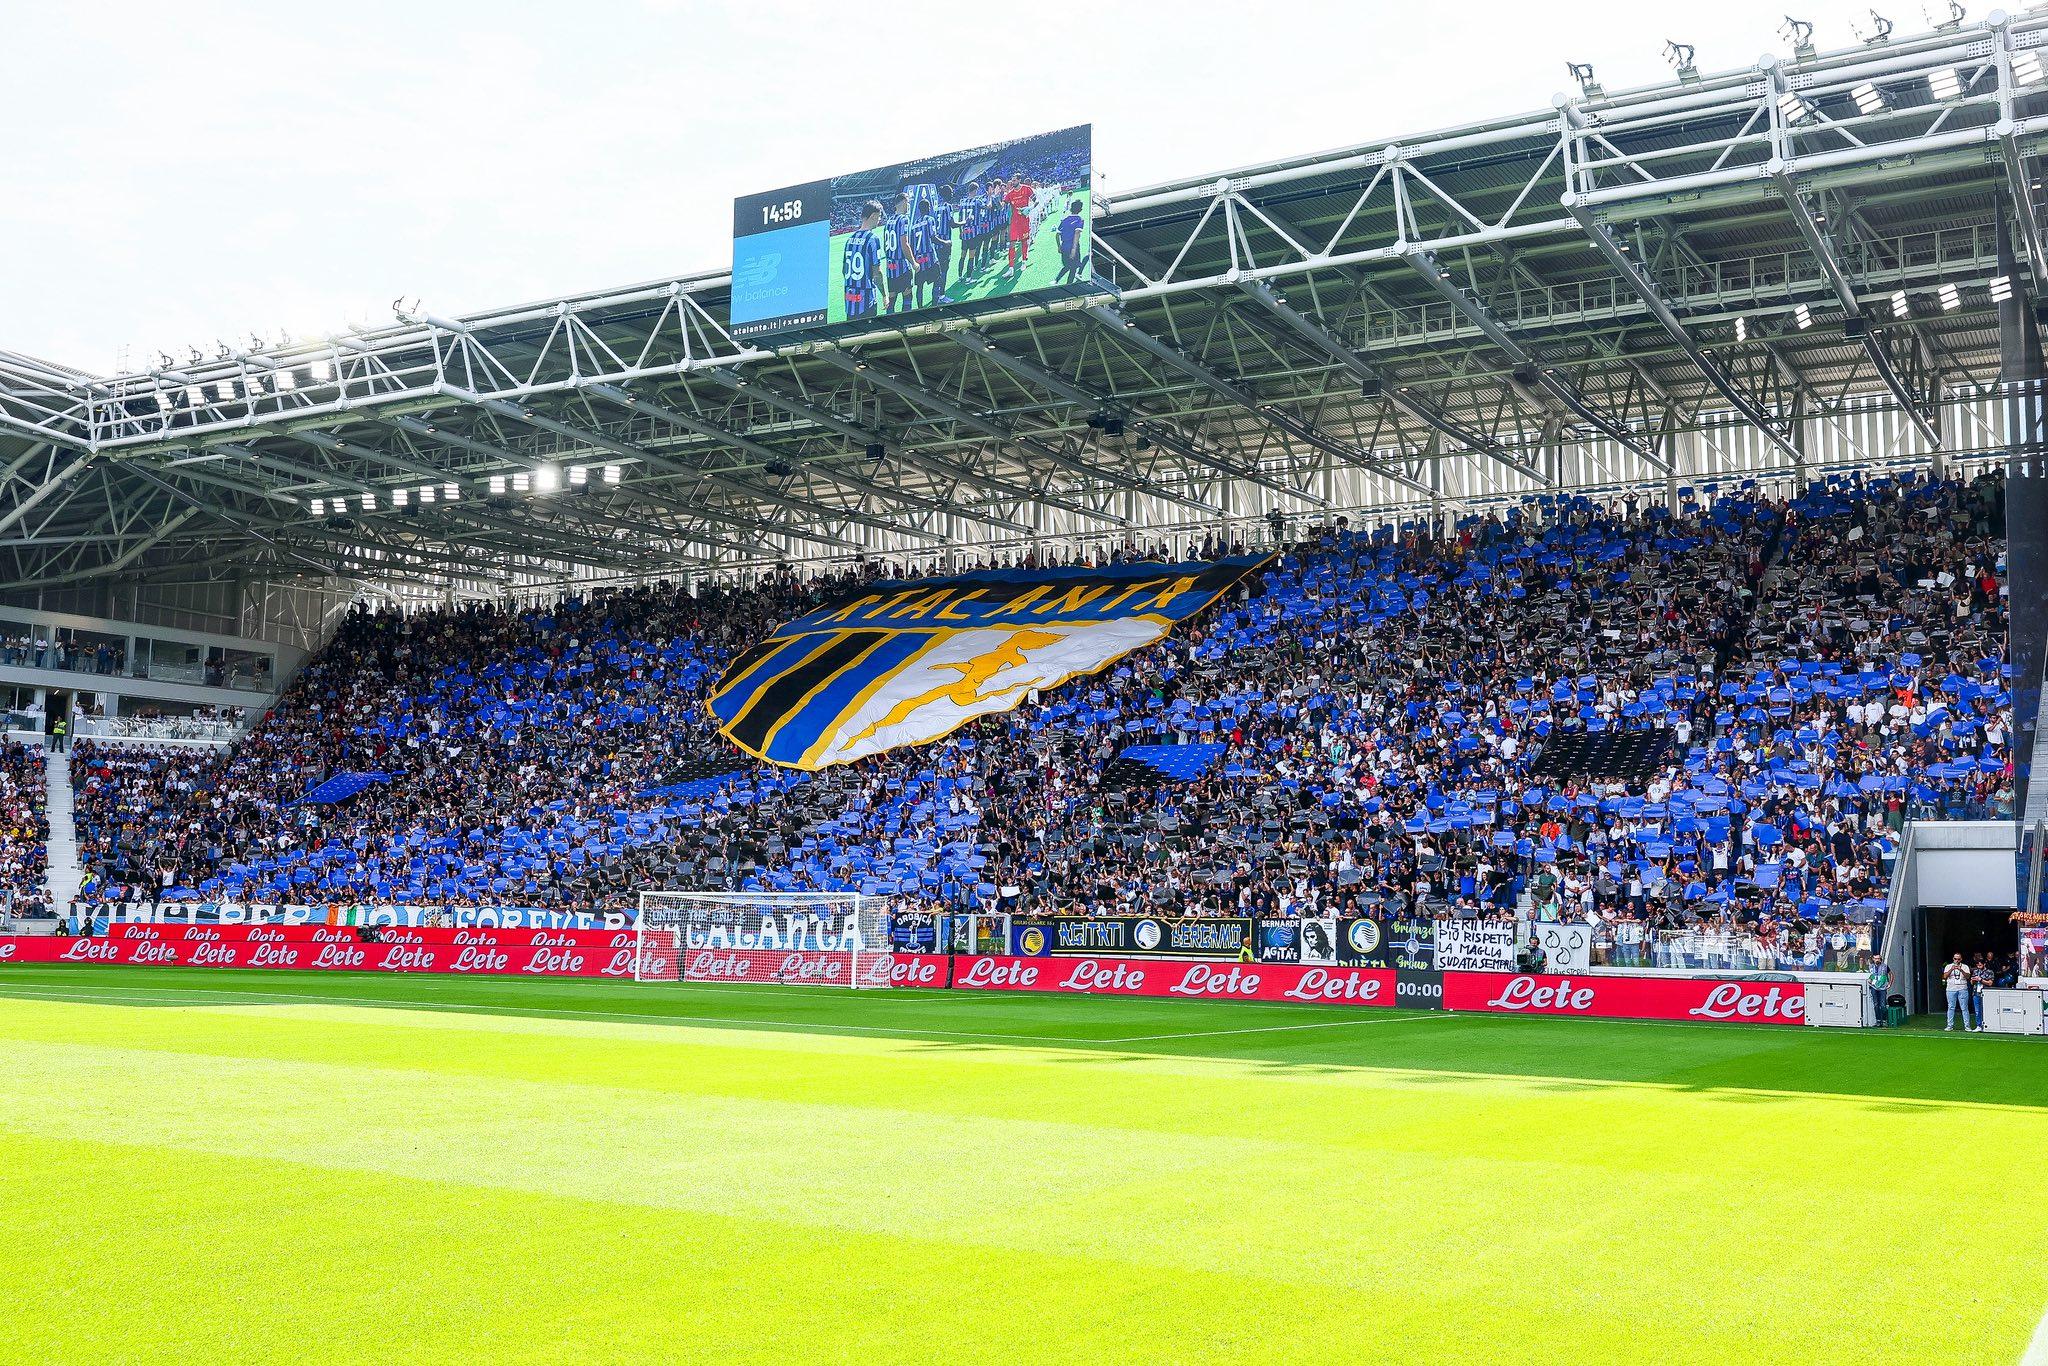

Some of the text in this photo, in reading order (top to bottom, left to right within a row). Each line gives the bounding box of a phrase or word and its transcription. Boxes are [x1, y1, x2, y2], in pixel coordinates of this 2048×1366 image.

[762, 199, 803, 225] 14:58
[733, 321, 778, 336] atalanta.it
[812, 575, 1201, 626] ATALANTA
[1059, 922, 1125, 946] AGITATI
[1171, 924, 1241, 949] BERGAMO
[1261, 920, 1300, 928] BERNARDE
[60, 938, 119, 960] Lete
[1438, 941, 1502, 958] LA MAGLIA
[1463, 931, 1513, 946] RISPETTO
[128, 941, 176, 962] Lete
[187, 942, 236, 964] Lete
[247, 943, 298, 966] Lete
[311, 944, 365, 967] Lete
[378, 945, 435, 969] Lete
[449, 946, 508, 971] Lete
[522, 947, 584, 973] Lete
[1262, 946, 1298, 960] AGITATE
[1438, 956, 1478, 969] SUDATA
[684, 951, 751, 978] Lete
[770, 953, 841, 980] Lete
[861, 954, 937, 982] Lete
[958, 957, 1039, 986] Lete
[1059, 960, 1145, 990] Lete
[1169, 964, 1261, 995] Lete
[1284, 968, 1381, 1000] Lete
[1396, 982, 1443, 998] 00:00
[1487, 976, 1595, 1010] Lete
[1689, 983, 1804, 1018] Lete
